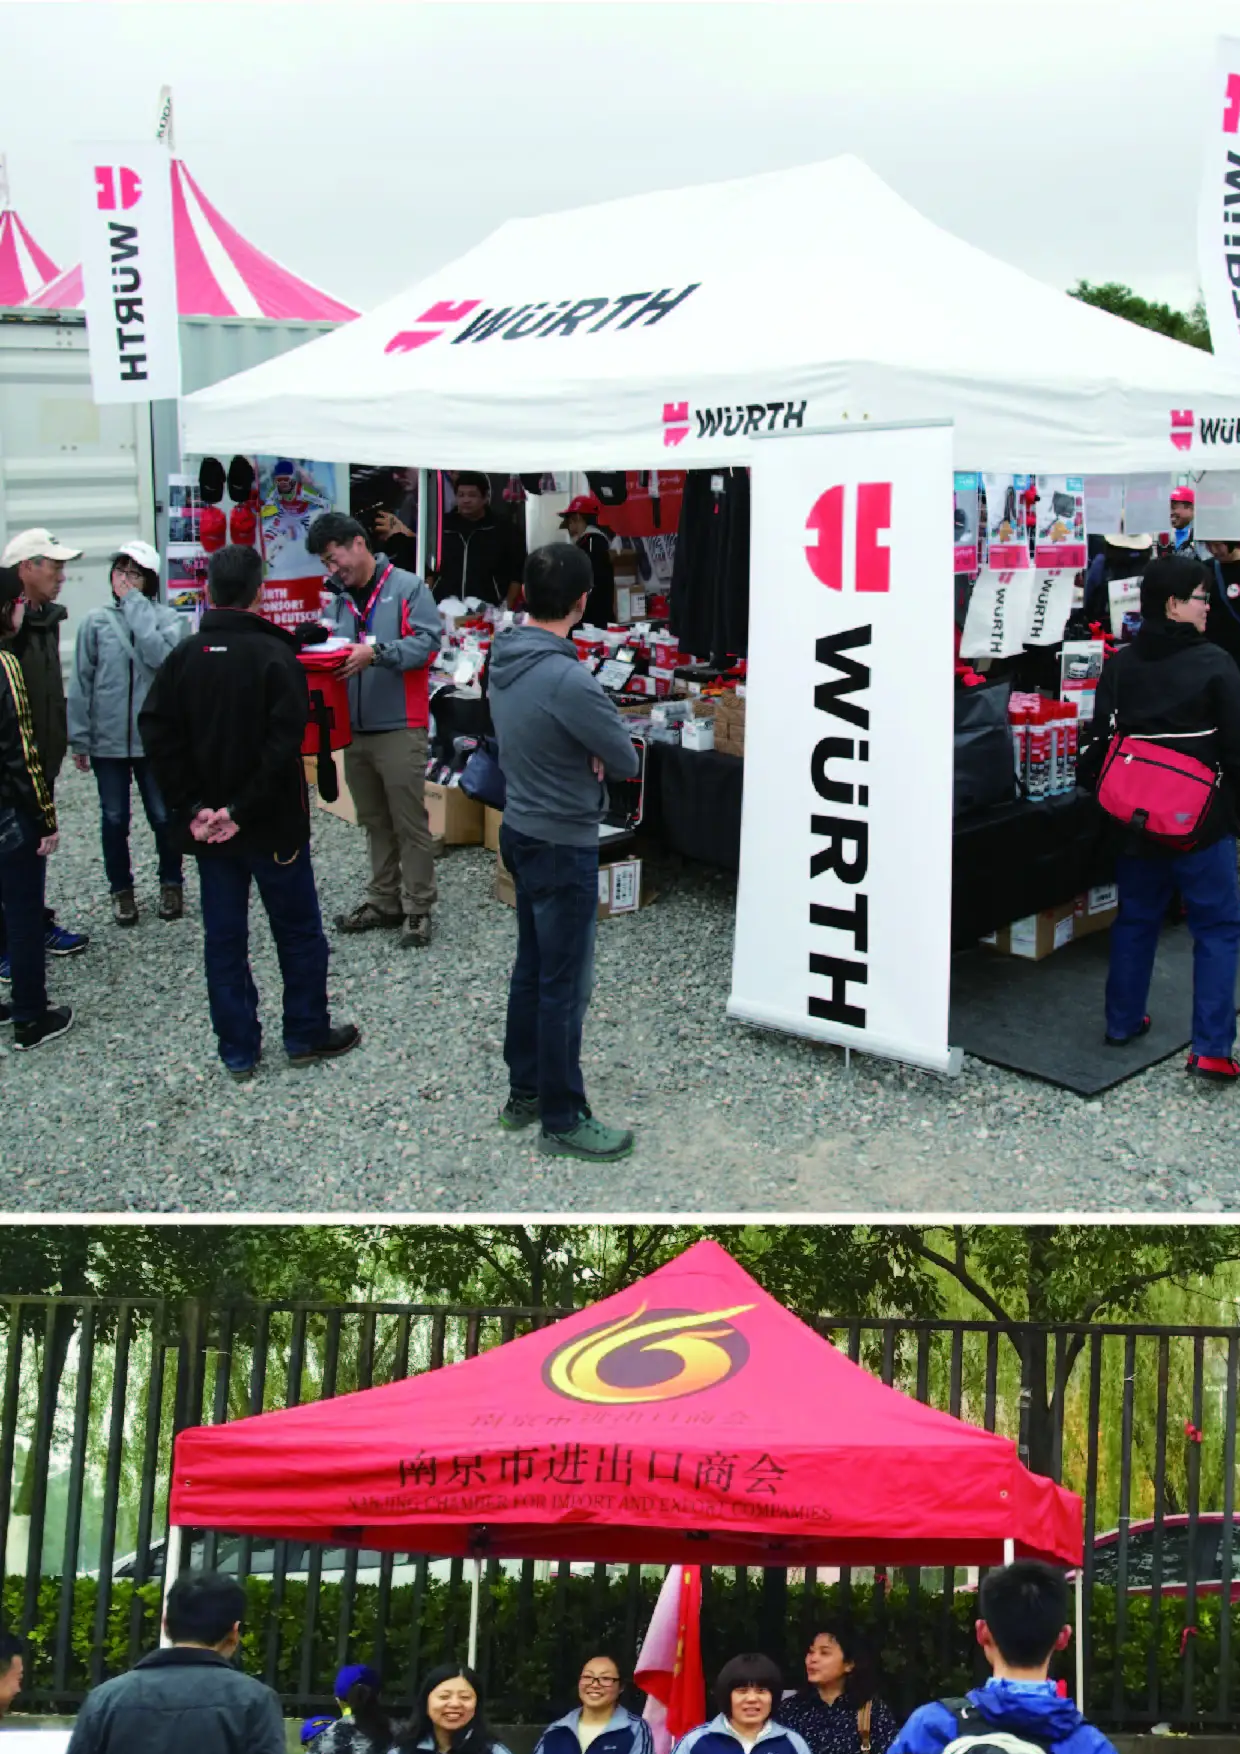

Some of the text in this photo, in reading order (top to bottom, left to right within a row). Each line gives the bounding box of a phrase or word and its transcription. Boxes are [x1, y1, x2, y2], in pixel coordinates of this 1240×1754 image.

[451, 283, 701, 345] WÜRTH
[696, 401, 807, 438] WÜRTH
[807, 623, 873, 1029] WÜRTH
[398, 1443, 788, 1496] 南京市进出口商会
[513, 1494, 548, 1510] FOR
[551, 1494, 614, 1510] IMPORT
[620, 1496, 656, 1513] AND
